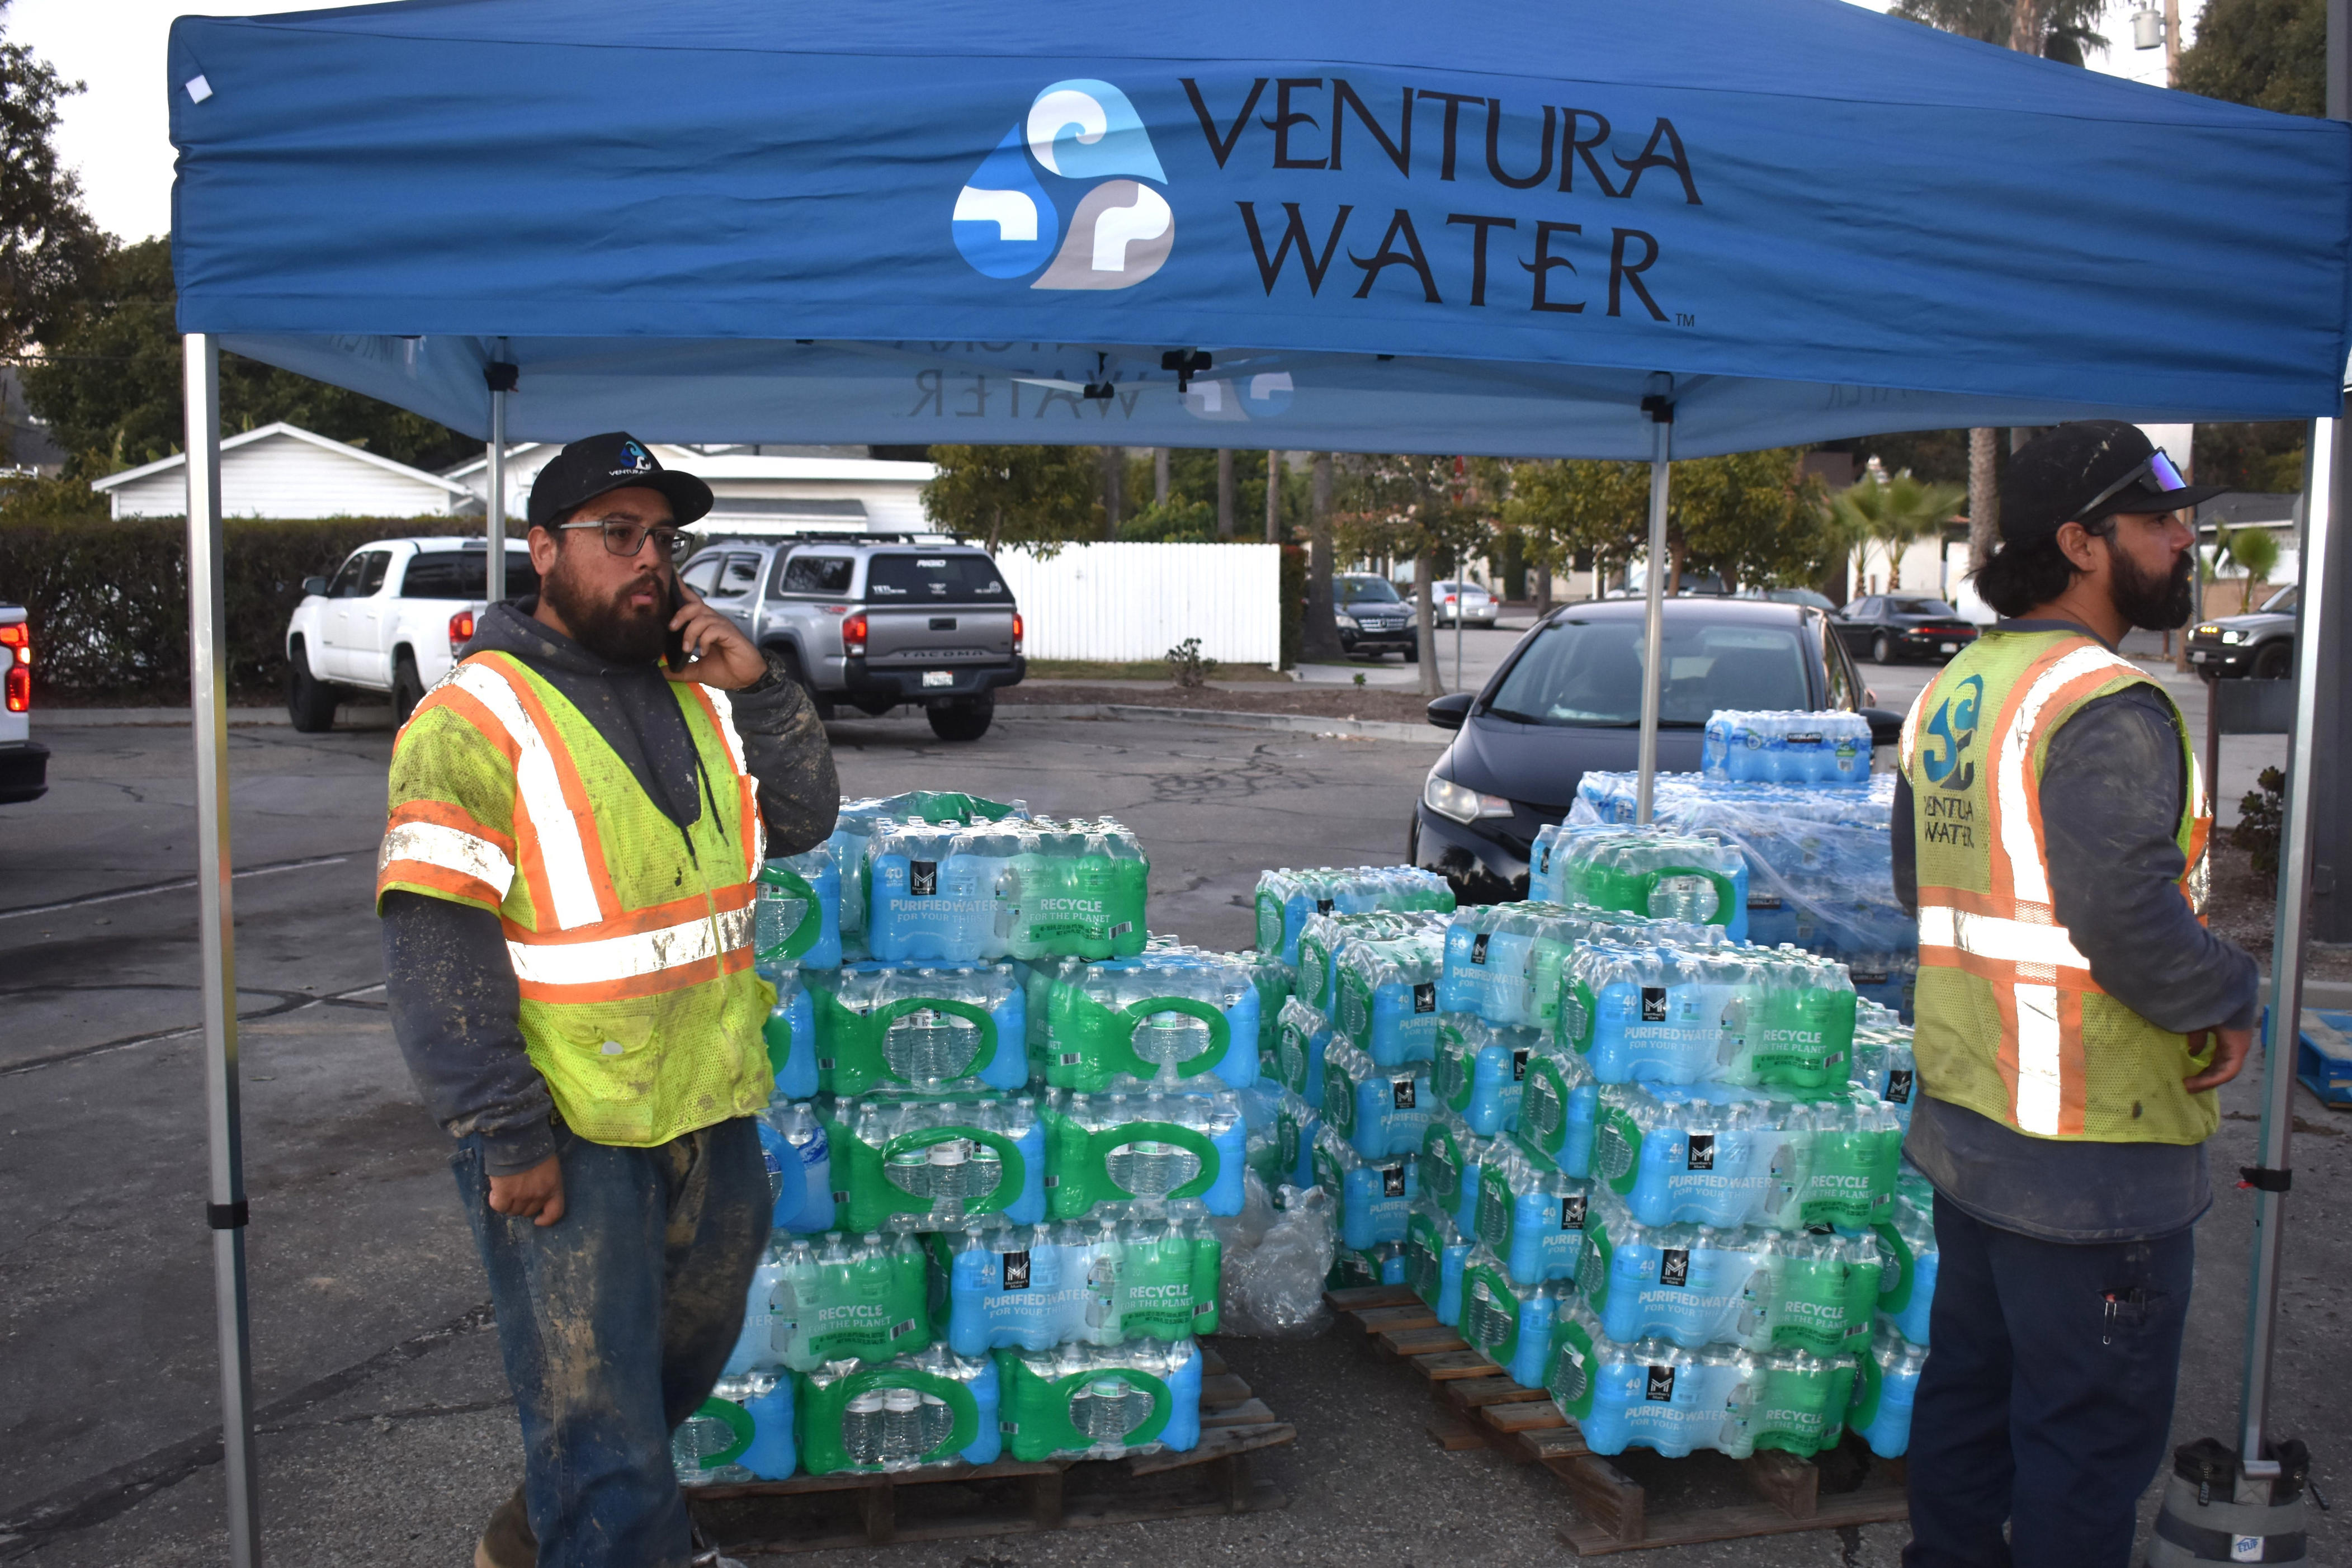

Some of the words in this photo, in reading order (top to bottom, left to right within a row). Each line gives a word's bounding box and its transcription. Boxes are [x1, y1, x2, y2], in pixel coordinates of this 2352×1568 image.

[1178, 78, 1703, 205] VENTURA
[1235, 201, 1672, 322] WATER
[1925, 821, 1974, 848] WATER
[885, 867, 903, 879] 40
[890, 899, 951, 911] PURIFIED
[952, 899, 998, 913] WATER
[1040, 898, 1102, 912] RECYCLE
[897, 913, 918, 923] FOR
[922, 913, 949, 922] YOUR
[1029, 913, 1047, 921] FOR
[1073, 913, 1111, 923] PLANET
[1623, 995, 1637, 1007] 40
[1624, 1027, 1680, 1041] PURIFIED
[1682, 1029, 1723, 1041] WATER
[1763, 1029, 1822, 1043] RECYCLE
[1630, 1041, 1647, 1050] FOR
[1650, 1041, 1677, 1050] YOUR
[1792, 1044, 1827, 1054] PLANET
[1668, 1174, 1728, 1189] PURIFIED
[1730, 1177, 1773, 1189] WATER
[1812, 1175, 1870, 1189] RECYCLE
[1674, 1187, 1692, 1199] FOR
[1696, 1188, 1725, 1199] YOUR
[1542, 1207, 1556, 1217] 40
[1542, 1234, 1581, 1248] PURIFI
[982, 1264, 996, 1276] 40
[1640, 1260, 1655, 1271] 40
[1130, 1284, 1189, 1298] RECYCLE
[983, 1293, 1046, 1310] PURIFIED
[1047, 1288, 1090, 1303] WATER
[1162, 1296, 1194, 1307] PLANET
[1638, 1290, 1699, 1306] PURIFIED
[1701, 1296, 1745, 1310] WATER
[819, 1304, 884, 1321] RECYCLE
[990, 1307, 1010, 1319] FOR
[1014, 1307, 1043, 1316] YOUR
[1645, 1304, 1664, 1313] FOR
[1668, 1305, 1695, 1317] YOUR
[1785, 1301, 1845, 1319] RECYCLE
[833, 1320, 850, 1329] THE
[853, 1316, 891, 1328] PLANET
[1794, 1315, 1813, 1325] THE
[1626, 1377, 1641, 1390] 40
[1624, 1405, 1684, 1421] PURIFIED
[1685, 1410, 1728, 1421] WATER
[1766, 1409, 1822, 1424] RECYCLE
[1652, 1419, 1679, 1431] YOUR
